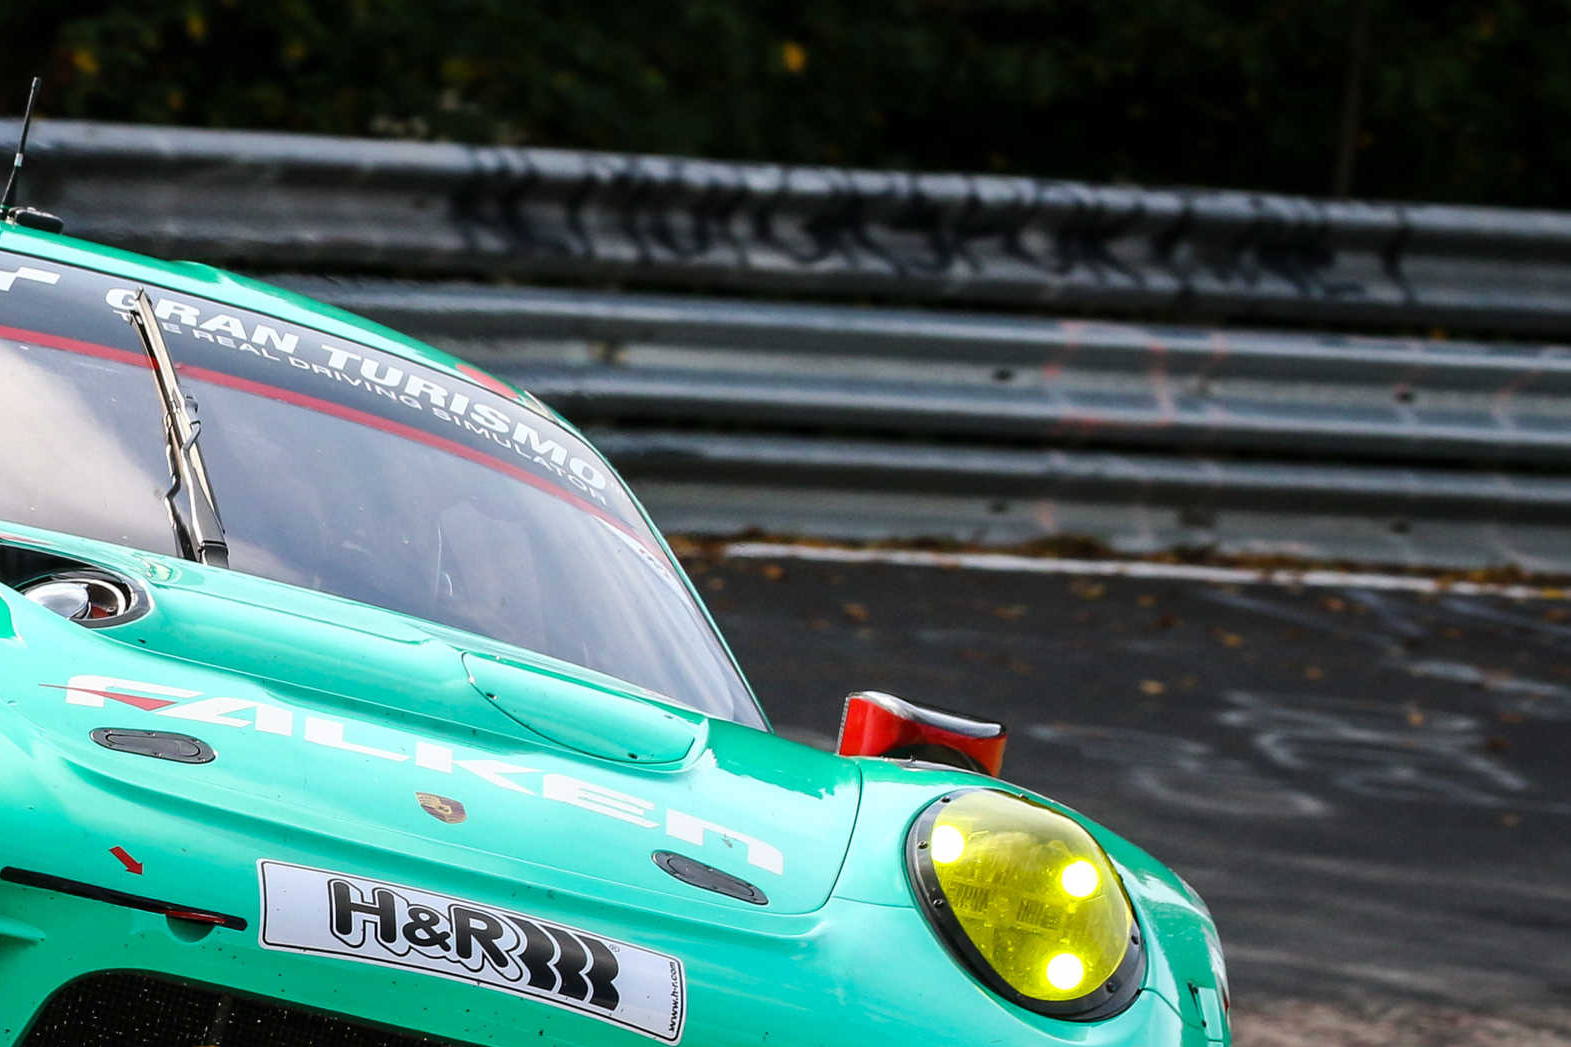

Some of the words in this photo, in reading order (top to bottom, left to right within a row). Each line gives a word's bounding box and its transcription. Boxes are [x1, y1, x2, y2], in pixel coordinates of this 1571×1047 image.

[105, 287, 300, 354] GRAN
[321, 343, 608, 491] TURISMO
[112, 309, 182, 335] TE
[192, 328, 281, 362] REAL
[288, 356, 425, 412] DRIVING
[431, 406, 608, 506] SIMULATOR
[328, 877, 520, 979] H&R
